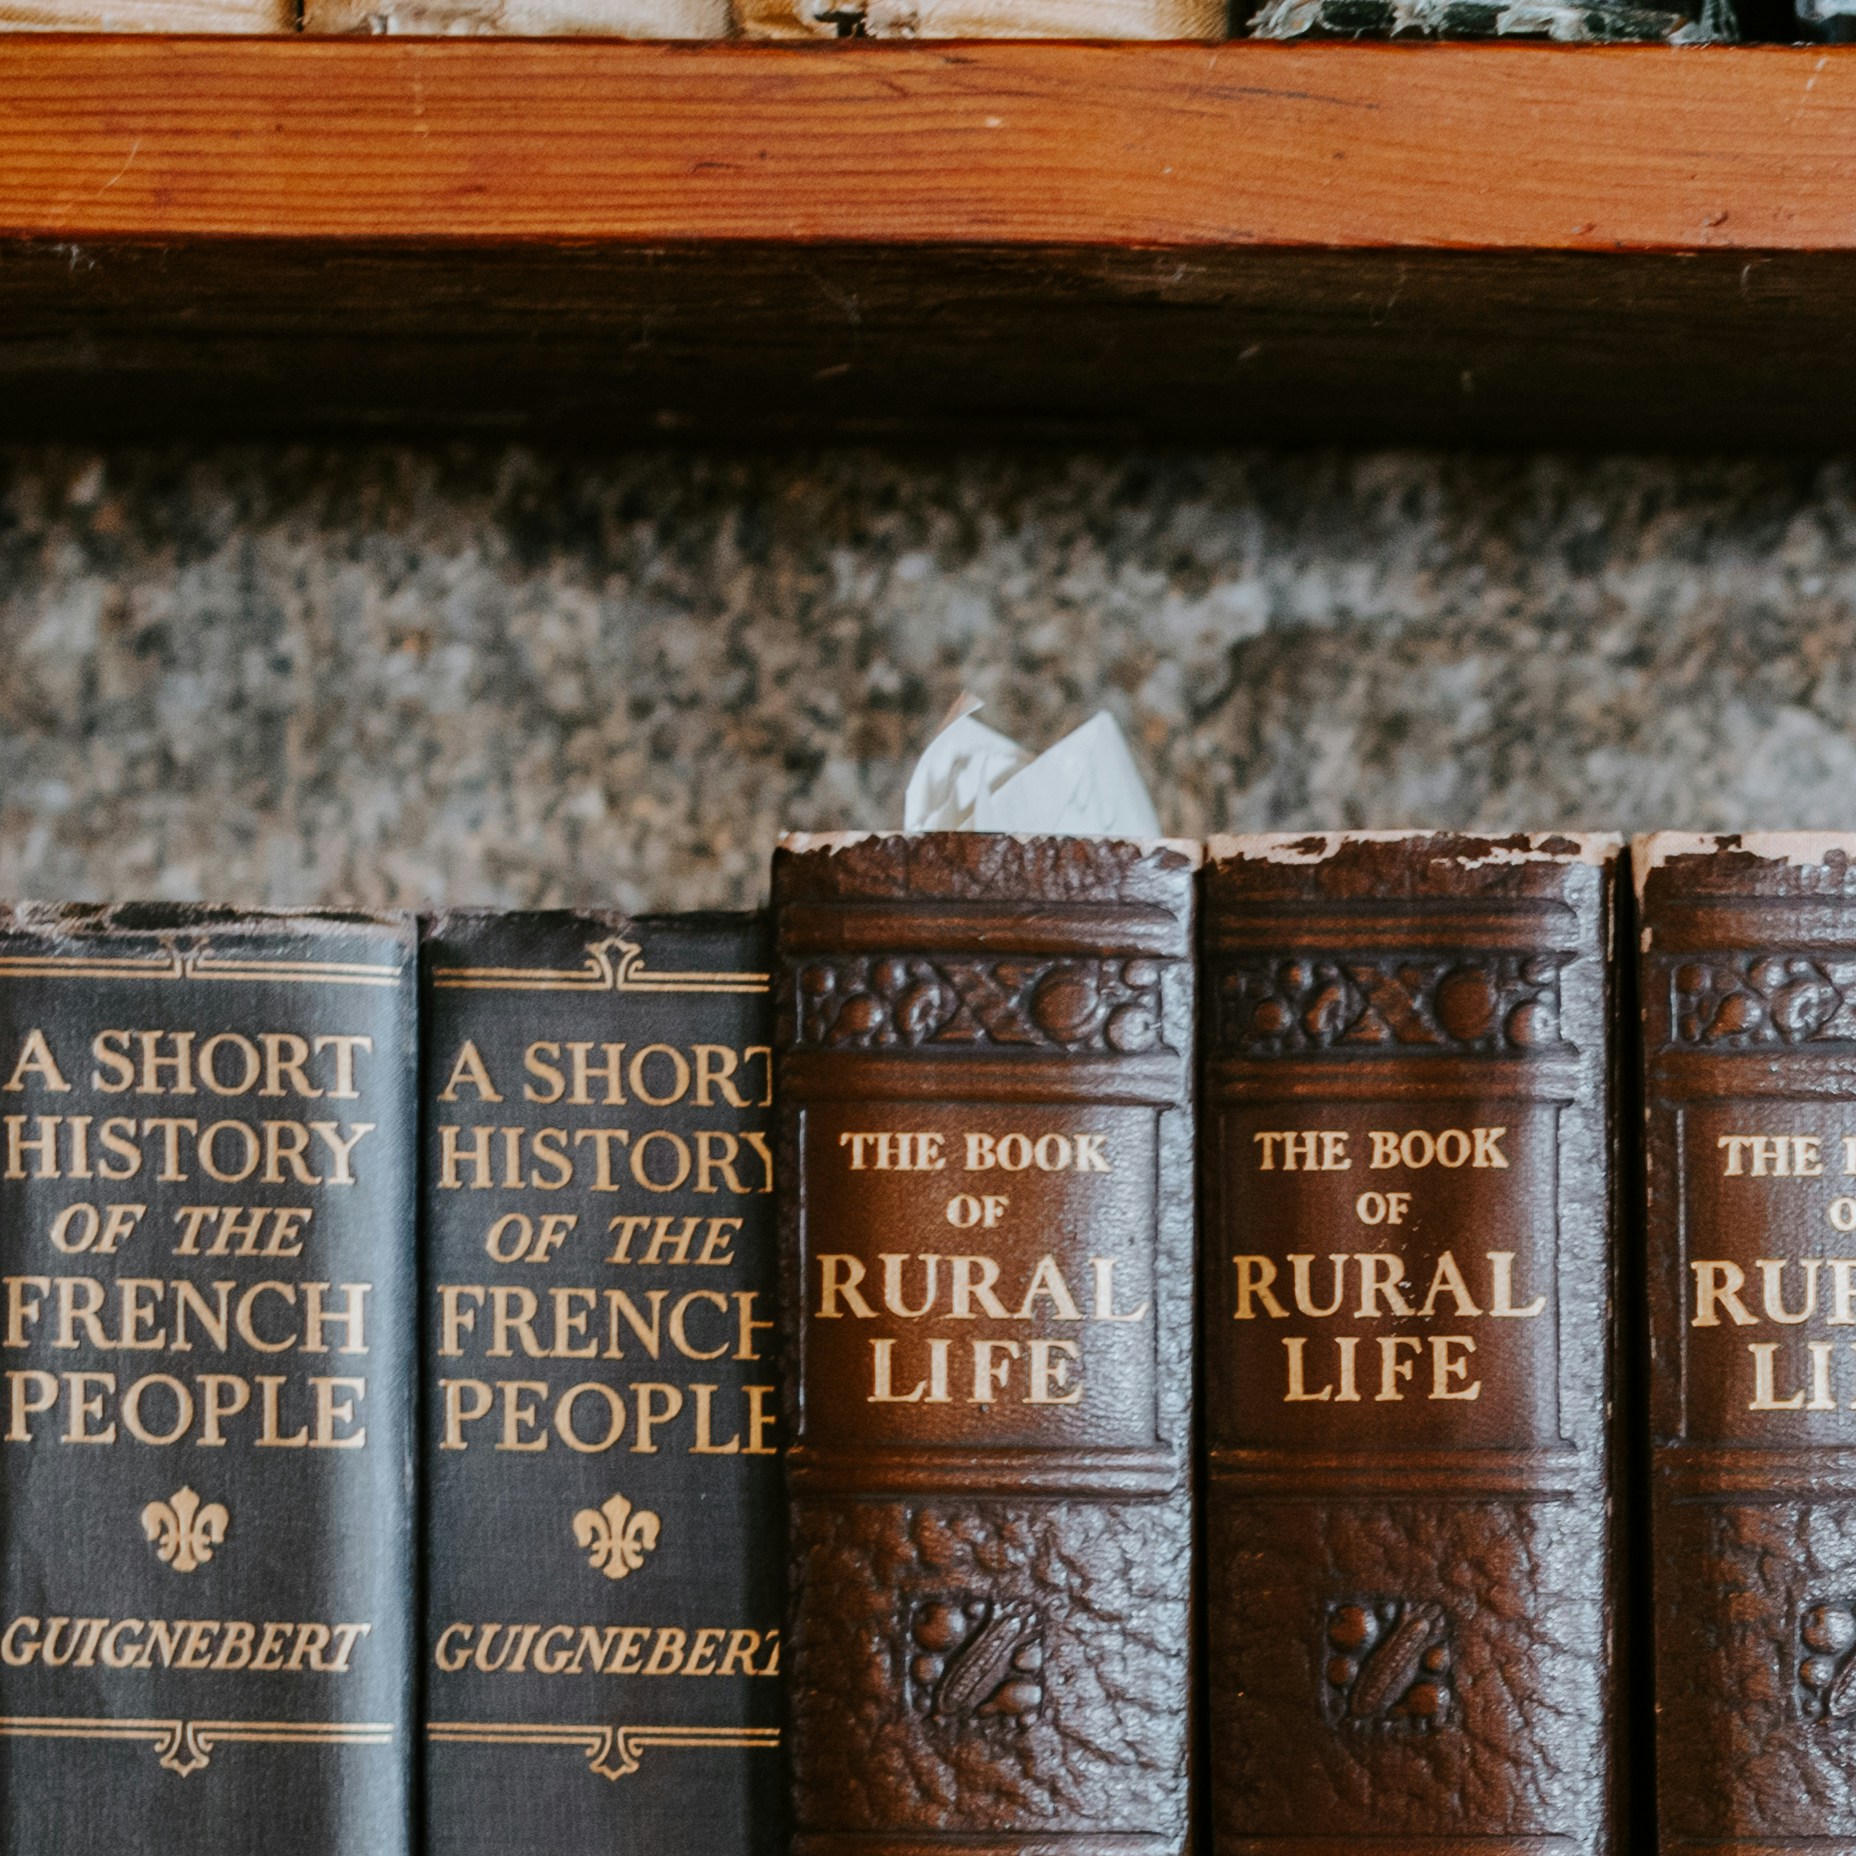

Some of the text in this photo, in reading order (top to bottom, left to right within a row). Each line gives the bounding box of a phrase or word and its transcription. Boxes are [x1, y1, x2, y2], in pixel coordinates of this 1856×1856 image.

[6, 1030, 373, 1099] A SHORT
[4, 1116, 377, 1185] HISTORY
[840, 1132, 1113, 1173] THE BOOK
[1254, 1127, 1509, 1171] THE BOOK
[1718, 1135, 1823, 1177] THE
[50, 1203, 312, 1257] OF THE
[486, 1214, 742, 1266] OF THE
[2, 1276, 373, 1355] FRENCH
[815, 1253, 1147, 1322] RURAL
[1234, 1251, 1546, 1320] RURAL
[867, 1339, 1082, 1404] LIFE
[1283, 1335, 1481, 1402] LIFE
[4, 1371, 367, 1448] PEOPLE
[1, 1617, 370, 1674] GUIGNEBERT
